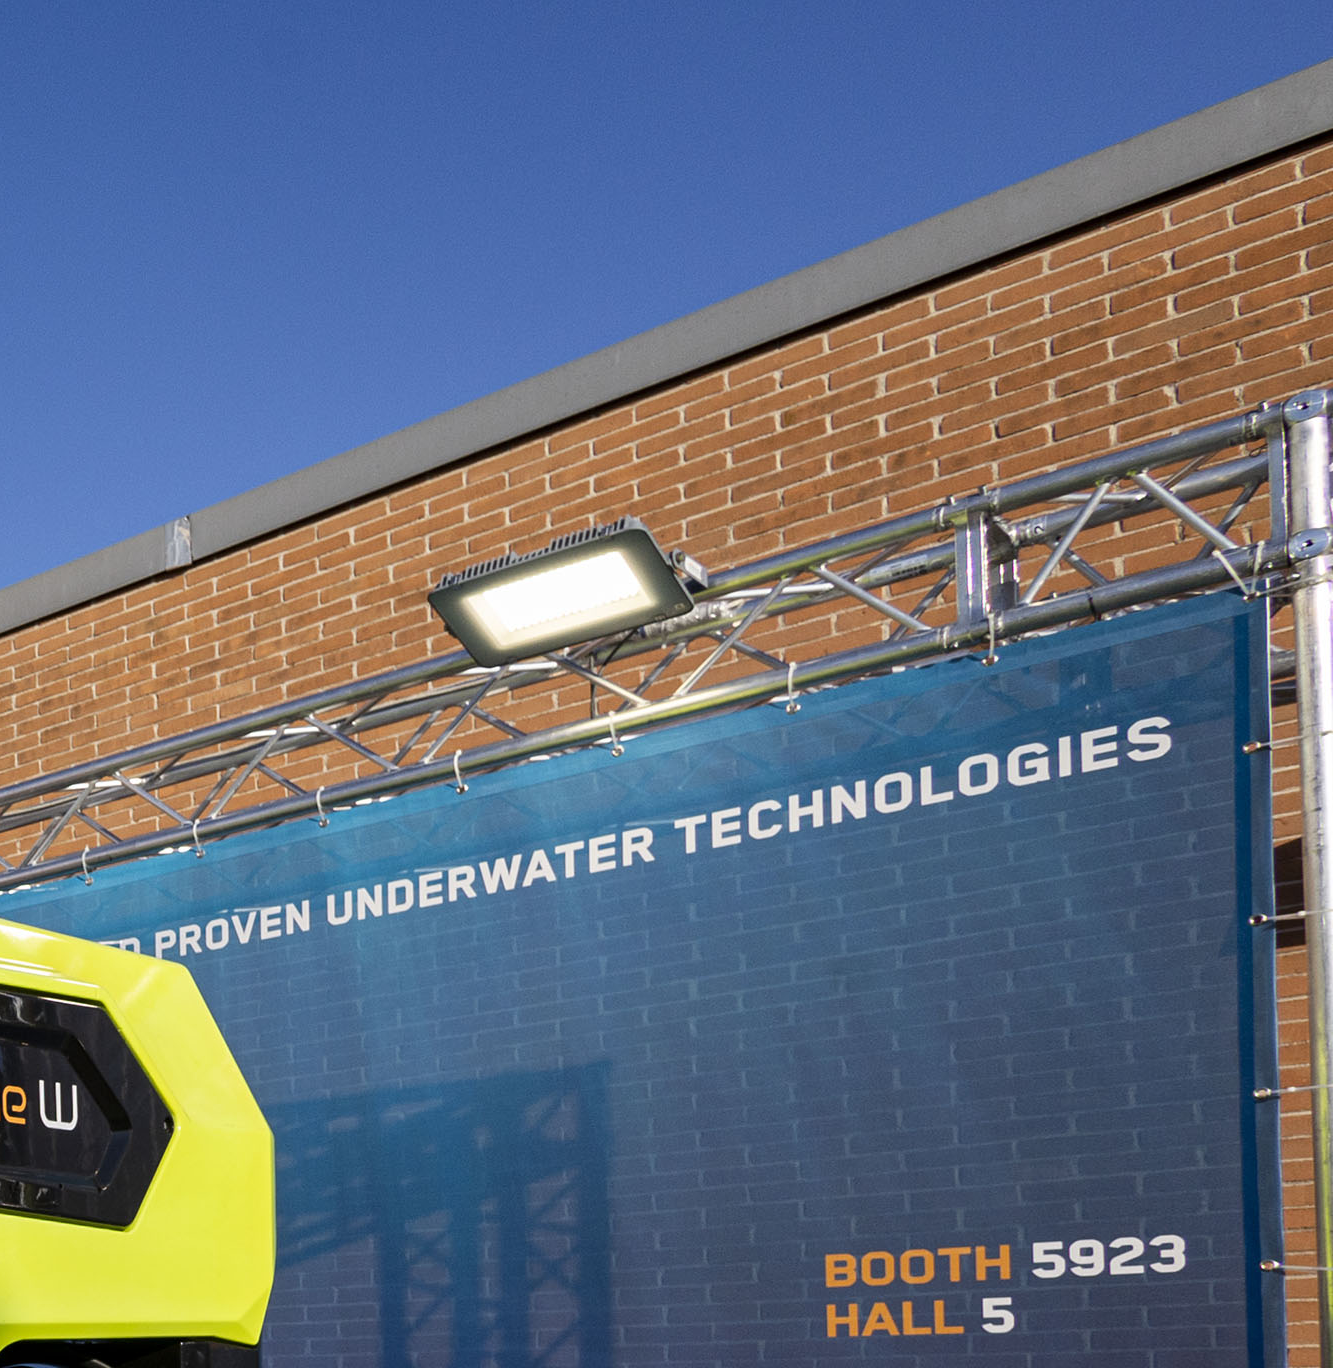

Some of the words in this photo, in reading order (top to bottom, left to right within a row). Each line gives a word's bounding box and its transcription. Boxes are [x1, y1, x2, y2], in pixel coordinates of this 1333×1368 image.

[154, 900, 310, 959] PROVEN
[327, 826, 655, 926] UNDERWATER
[674, 716, 1172, 854] TECHNOLOGIES
[825, 1244, 1012, 1288] BOOTH
[1031, 1234, 1186, 1279] 5923
[826, 1299, 965, 1338] HALL
[981, 1296, 1016, 1334] 5
